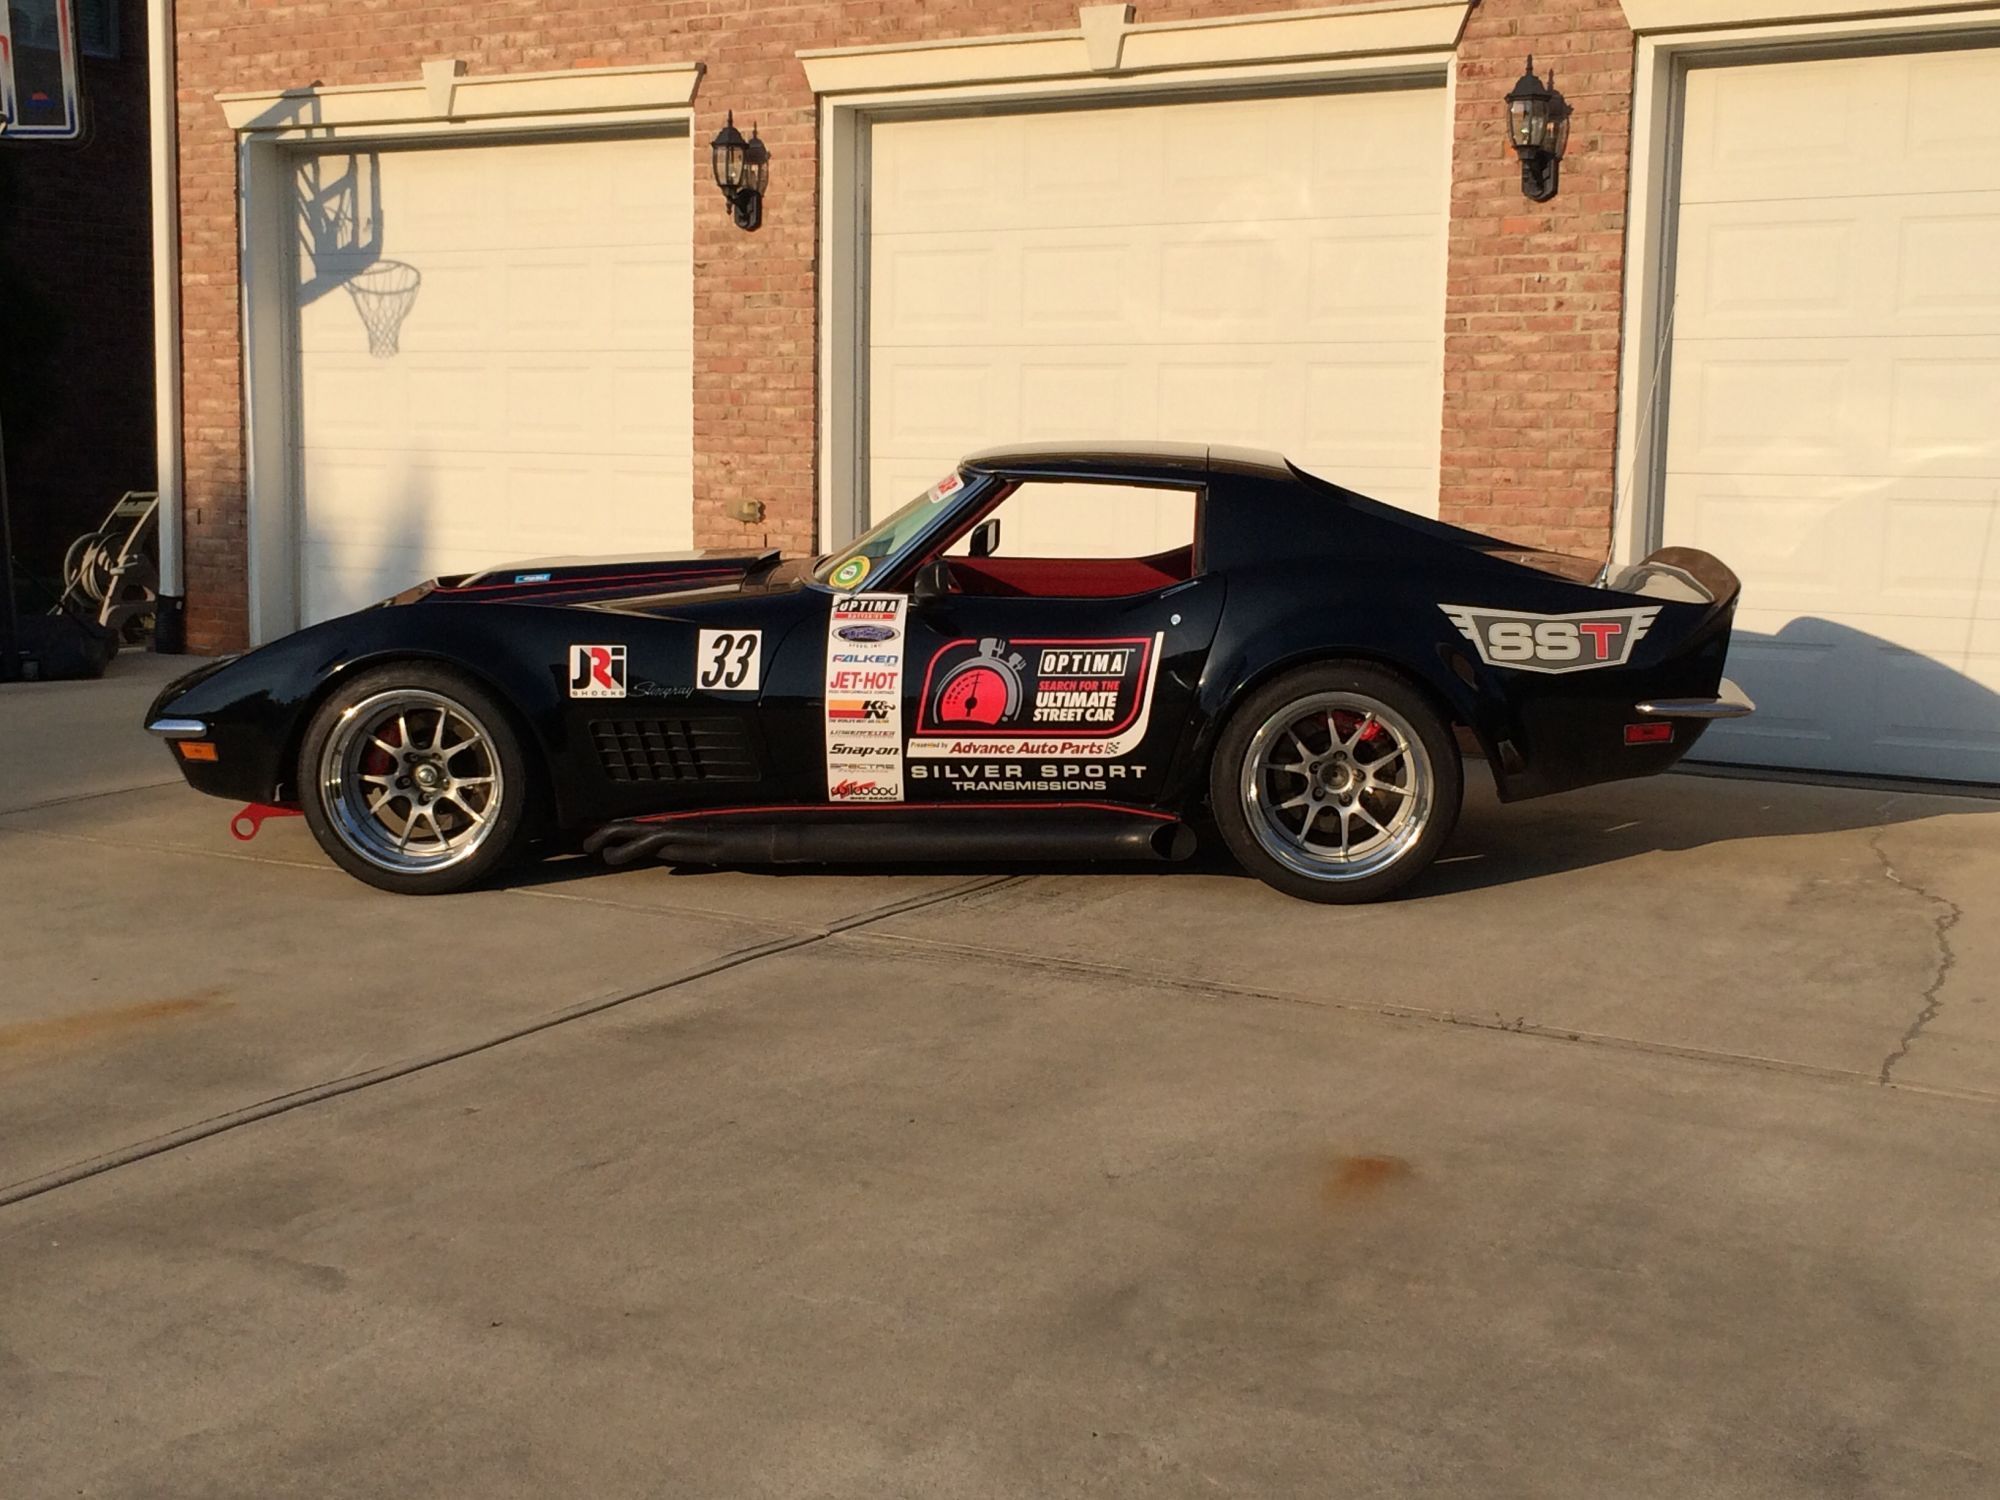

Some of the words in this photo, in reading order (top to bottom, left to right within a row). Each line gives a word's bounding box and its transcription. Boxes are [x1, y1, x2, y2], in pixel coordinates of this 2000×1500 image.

[839, 600, 897, 612] OPTIMA
[1488, 622, 1622, 660] SST
[701, 634, 758, 688] 33
[832, 654, 899, 664] FALKEN
[1043, 654, 1123, 673] OPTIMA
[627, 681, 695, 698] Stingray
[1038, 681, 1078, 691] SEARCH
[1079, 681, 1099, 691] FOR
[1101, 681, 1120, 690] THE
[1035, 691, 1119, 708] ULTIMATE
[861, 700, 897, 719] K&N
[1032, 708, 1085, 722] STREET
[1085, 708, 1116, 722] CAR
[829, 743, 900, 757] Snap-on
[949, 742, 1015, 754] Advance
[1016, 741, 1059, 754] Auto
[1060, 741, 1104, 754] Parts
[911, 765, 1022, 778] SILVER
[1040, 765, 1147, 778] SPORT
[952, 781, 1107, 791] TRANSMISSIONS
